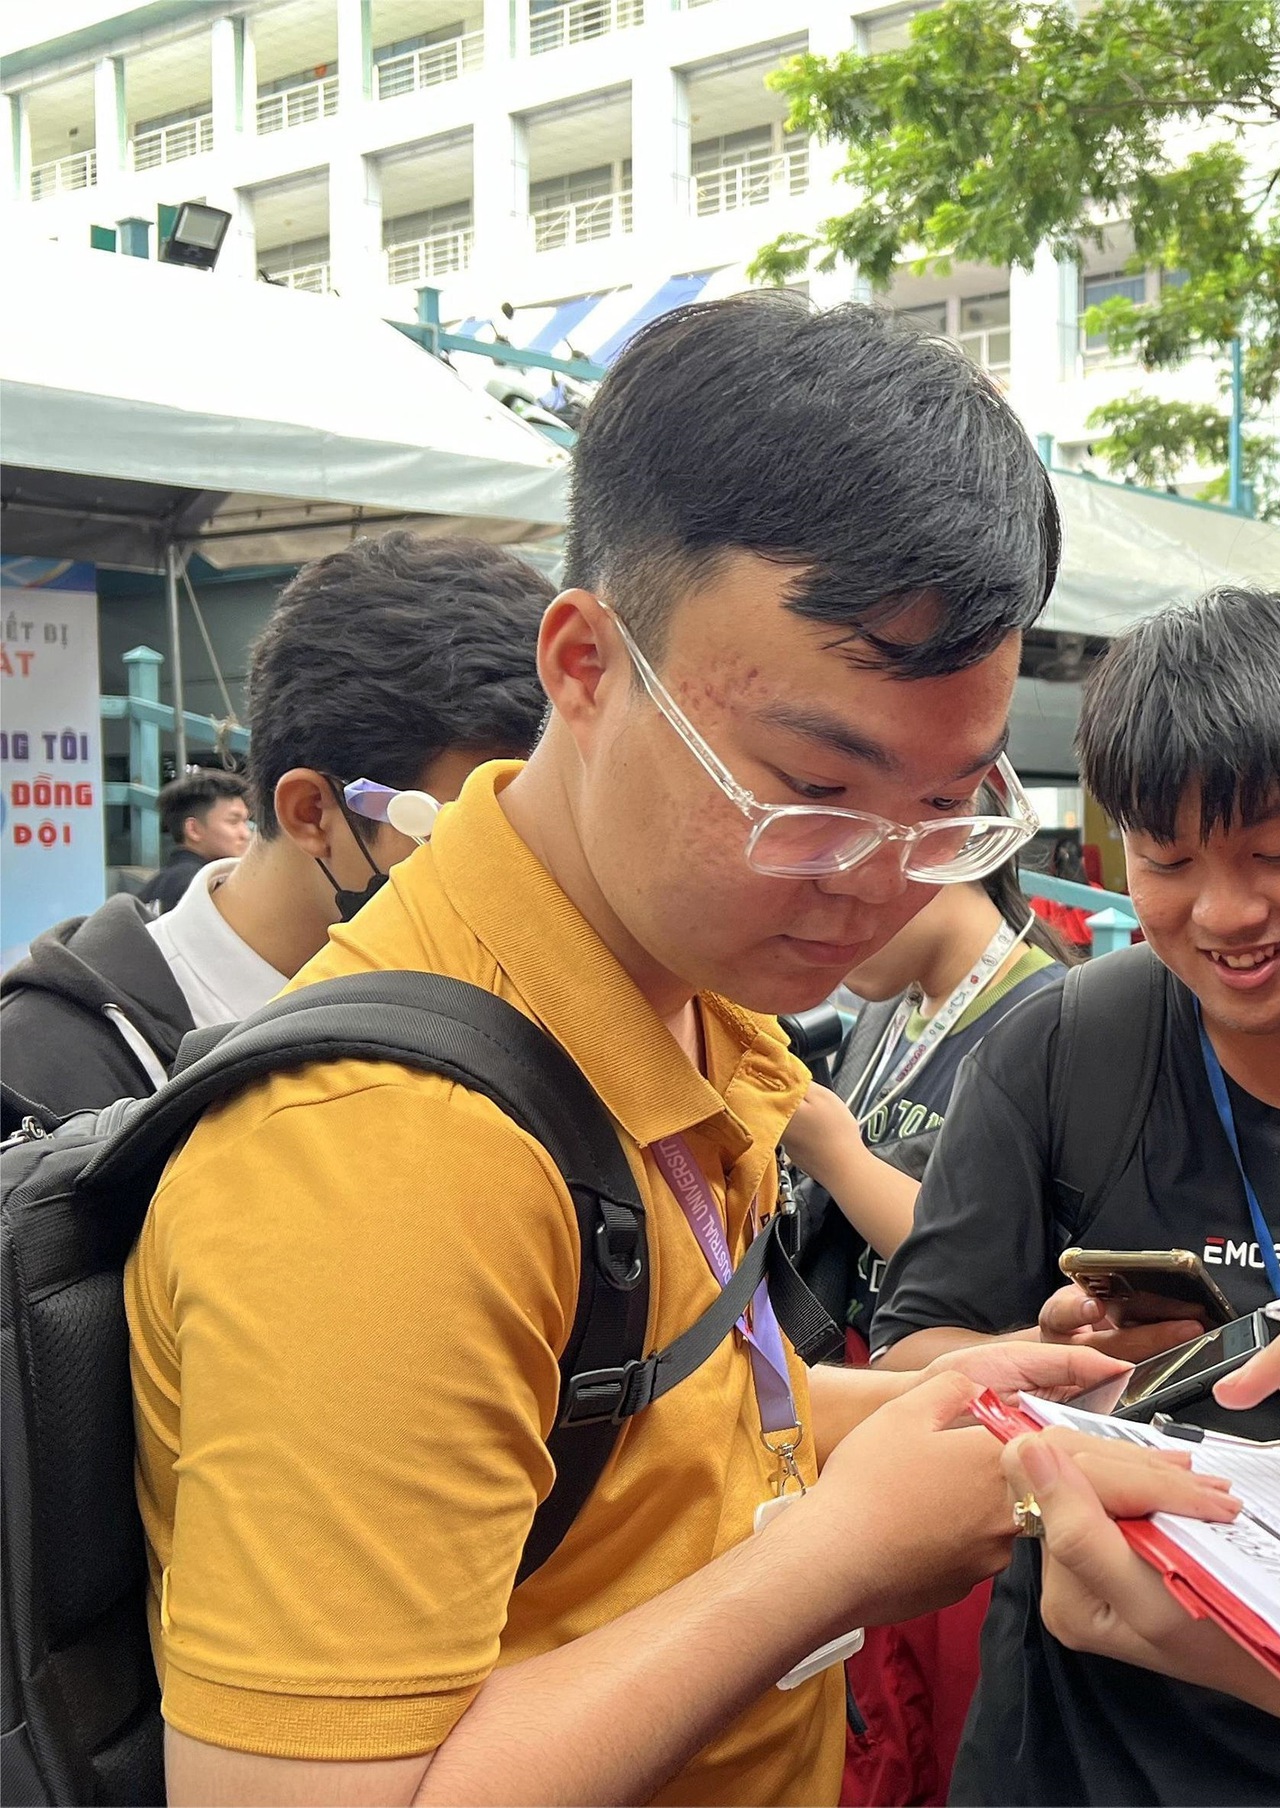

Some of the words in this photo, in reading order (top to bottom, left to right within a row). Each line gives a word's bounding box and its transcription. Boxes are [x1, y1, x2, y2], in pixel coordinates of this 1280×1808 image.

[0, 610, 34, 642] ẾT
[41, 727, 89, 762] TÔI
[658, 1140, 709, 1222] UNIVERSIT
